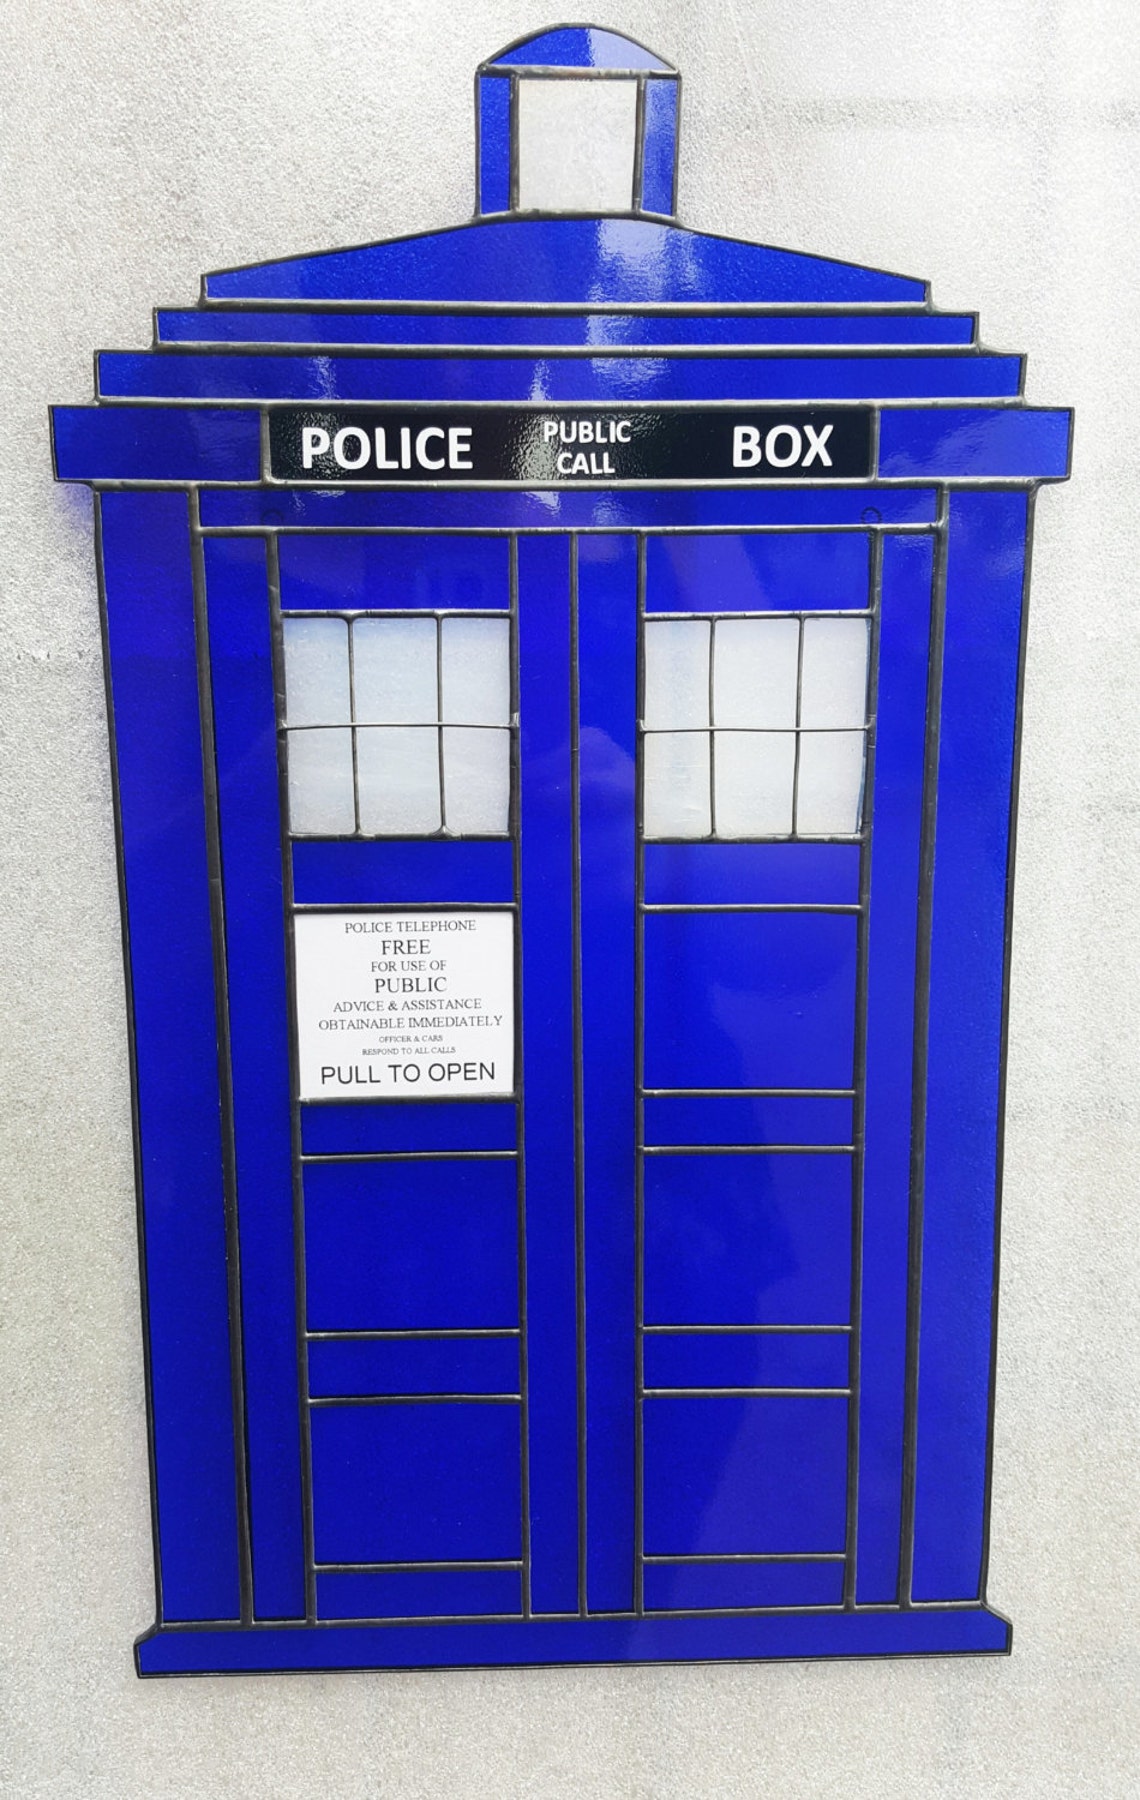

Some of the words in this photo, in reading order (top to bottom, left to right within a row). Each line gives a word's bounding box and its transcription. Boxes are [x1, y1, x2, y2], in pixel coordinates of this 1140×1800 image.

[543, 420, 632, 445] PUBLIC
[301, 426, 473, 470] POLICE
[732, 424, 834, 468] BOX
[556, 452, 616, 475] CALL
[345, 922, 393, 933] POLICE
[396, 920, 476, 932] TELEPHONE
[381, 939, 431, 955] FREE
[371, 961, 397, 972] FOR
[400, 960, 426, 972] USE
[429, 960, 447, 971] OF
[374, 977, 447, 993] PUBLIC
[333, 1001, 384, 1012] ADVICE
[387, 1001, 398, 1011] &
[401, 999, 482, 1011] ASSISTANCE
[318, 1018, 405, 1030] OBTAINABLE
[408, 1015, 503, 1028] IMMEDIATELY
[362, 1048, 399, 1056] RESPOND
[402, 1047, 413, 1055] TO
[414, 1047, 430, 1055] ALL
[431, 1046, 456, 1054] CALLS
[321, 1065, 381, 1085] PULL
[388, 1063, 421, 1083] TO
[428, 1061, 496, 1081] OPEN
